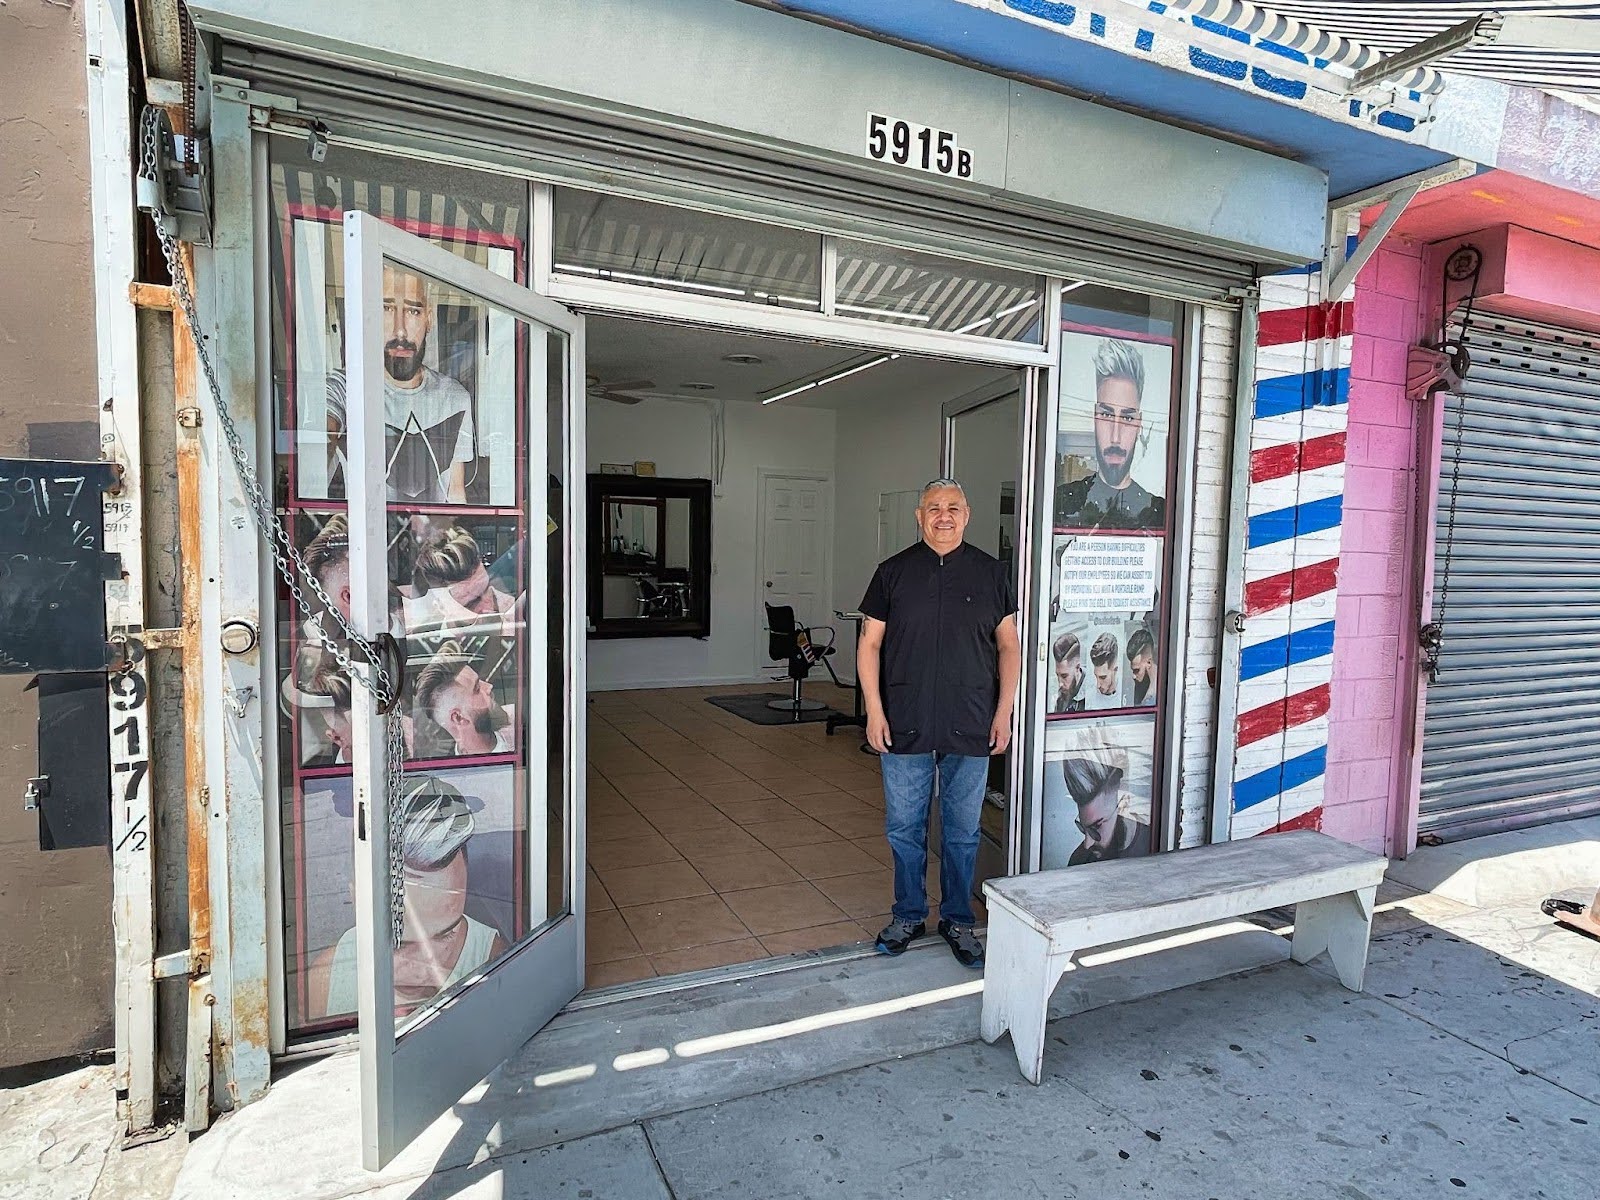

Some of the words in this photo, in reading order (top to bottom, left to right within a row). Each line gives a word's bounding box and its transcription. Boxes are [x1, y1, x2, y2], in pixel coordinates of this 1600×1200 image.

[1091, 542, 1106, 551] PERSON
[1081, 556, 1096, 566] ACCESS
[1111, 556, 1129, 566] BUILDING
[1130, 556, 1144, 566] PLEASE
[1131, 570, 1144, 580] ASSIST
